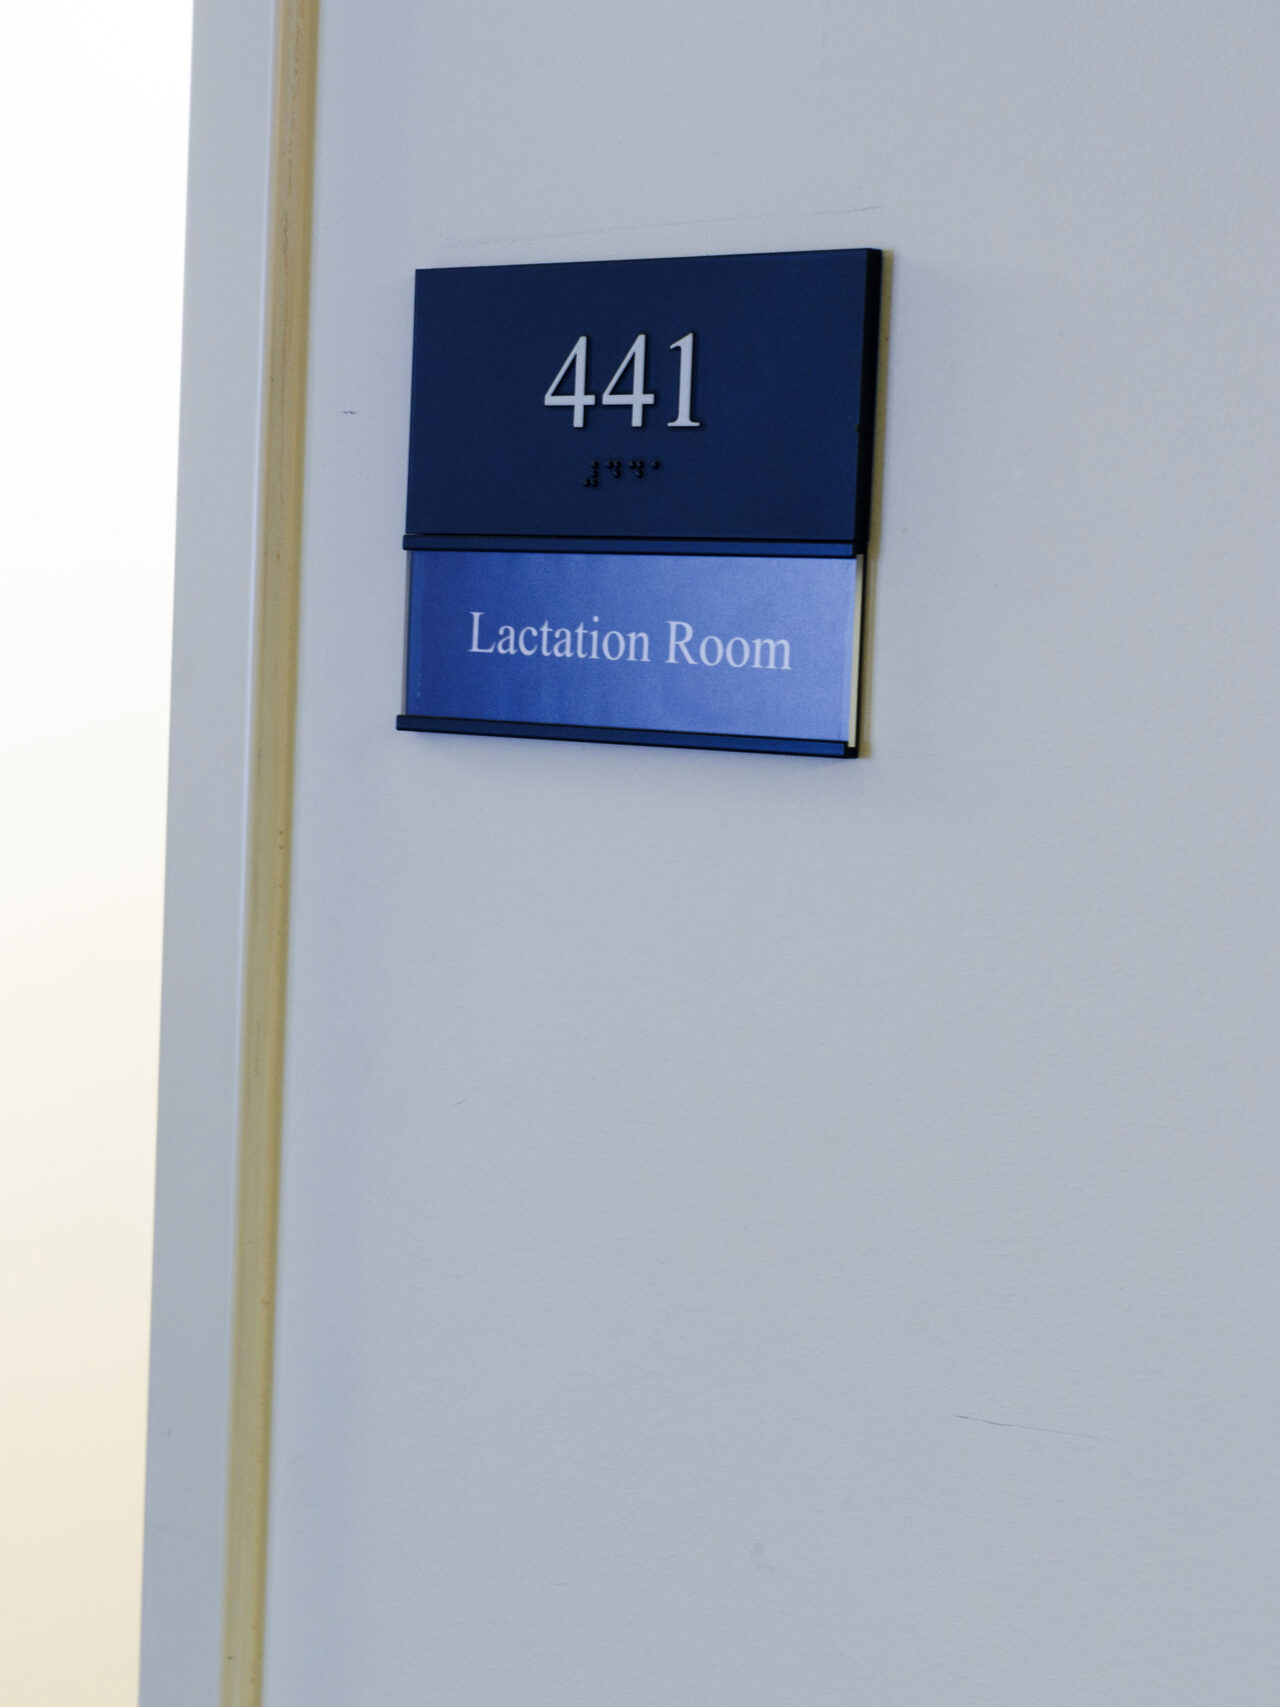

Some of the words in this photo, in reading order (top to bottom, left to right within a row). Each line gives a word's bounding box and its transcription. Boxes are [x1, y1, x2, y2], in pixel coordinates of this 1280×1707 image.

[543, 332, 701, 429] 441
[468, 611, 651, 663] Lactation
[664, 620, 793, 671] Room
